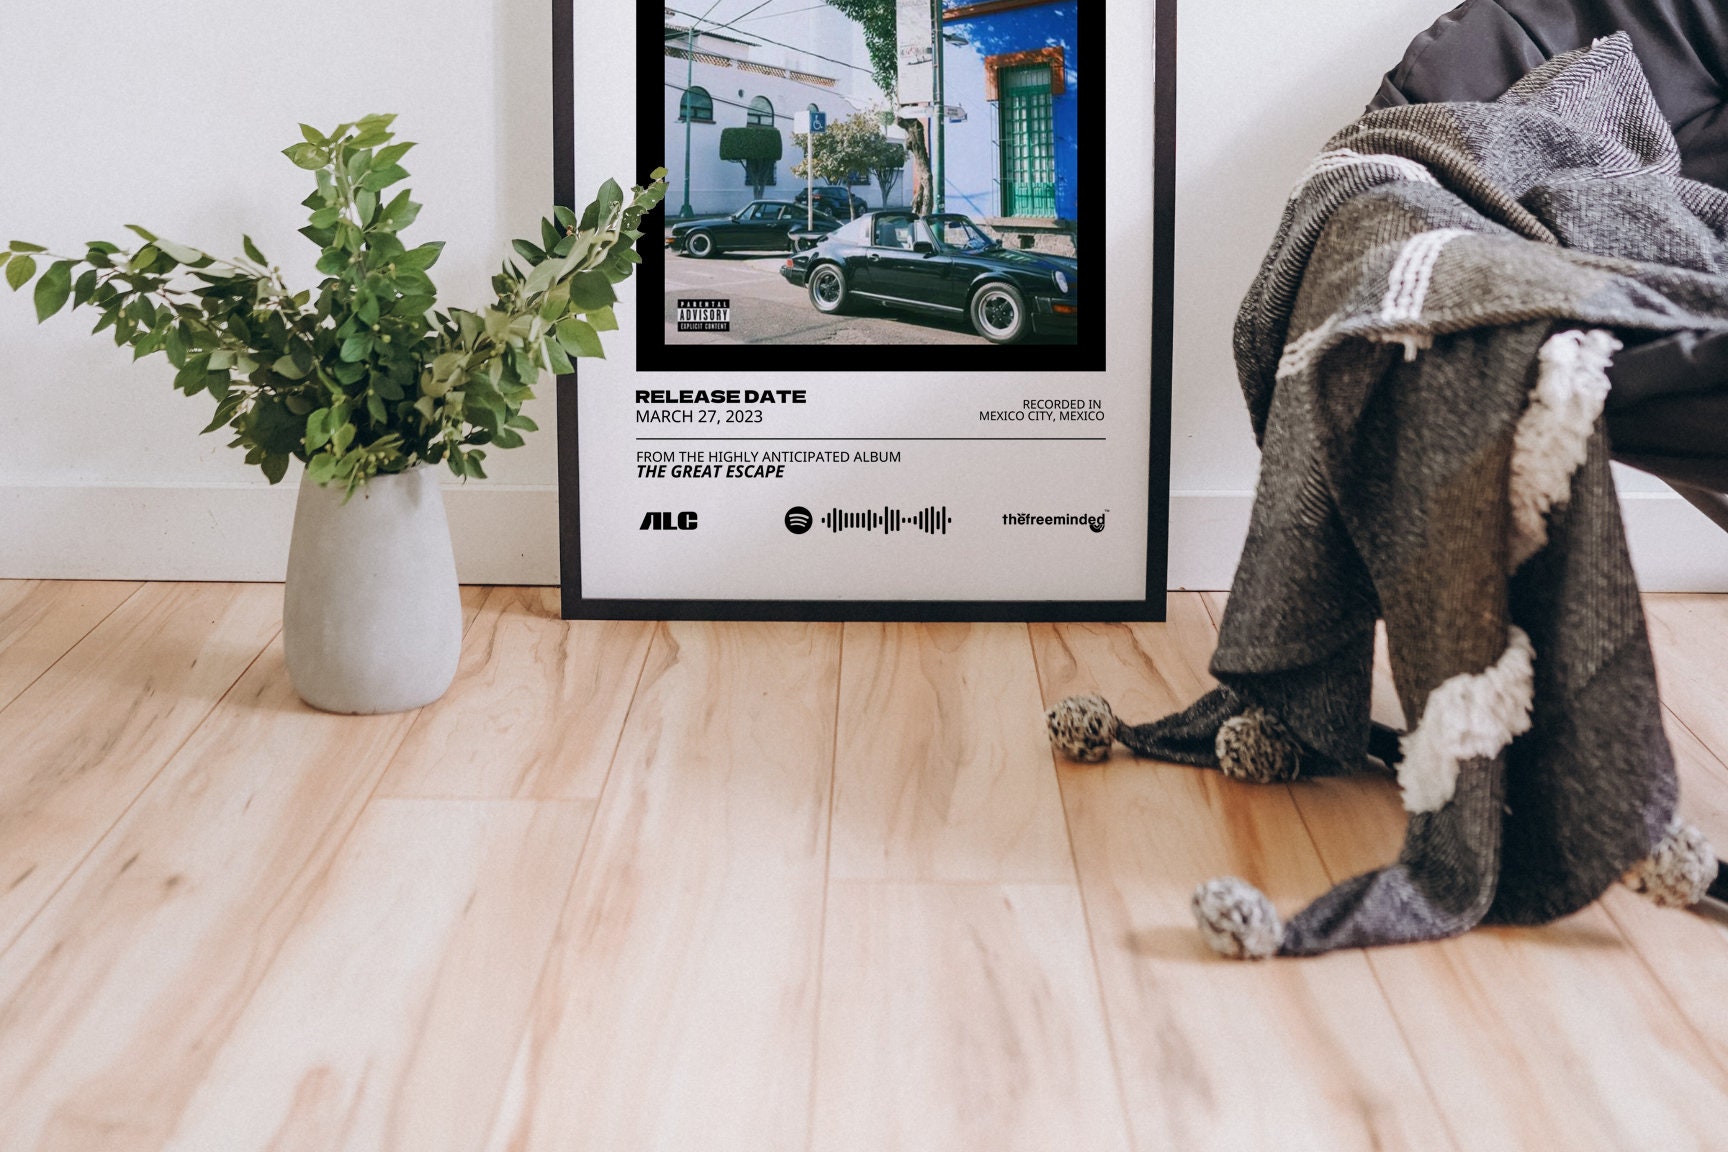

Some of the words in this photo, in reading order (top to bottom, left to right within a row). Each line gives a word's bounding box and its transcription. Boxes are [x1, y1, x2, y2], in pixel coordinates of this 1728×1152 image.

[679, 309, 728, 321] ADVISORY
[680, 322, 703, 330] EXPLICIT
[705, 322, 727, 330] CONTENT
[635, 390, 741, 404] RELEASE
[745, 390, 807, 404] DATE
[1023, 400, 1085, 410] RECORDED
[1088, 400, 1102, 410] IN
[636, 410, 693, 423] MARCH
[698, 410, 721, 425] 27,
[725, 410, 763, 423] 2023
[979, 411, 1025, 421] MEXICO
[1027, 411, 1056, 423] CITY,
[1059, 411, 1105, 421] MEXICO
[636, 452, 675, 463] FROM
[679, 452, 705, 463] THE
[709, 452, 759, 463] HIGHLY
[761, 452, 850, 463] ANTICIPATED
[853, 452, 901, 463] ALBUM
[637, 465, 667, 479] THE
[671, 465, 722, 479] GREAT
[726, 465, 785, 479] ESCAPE
